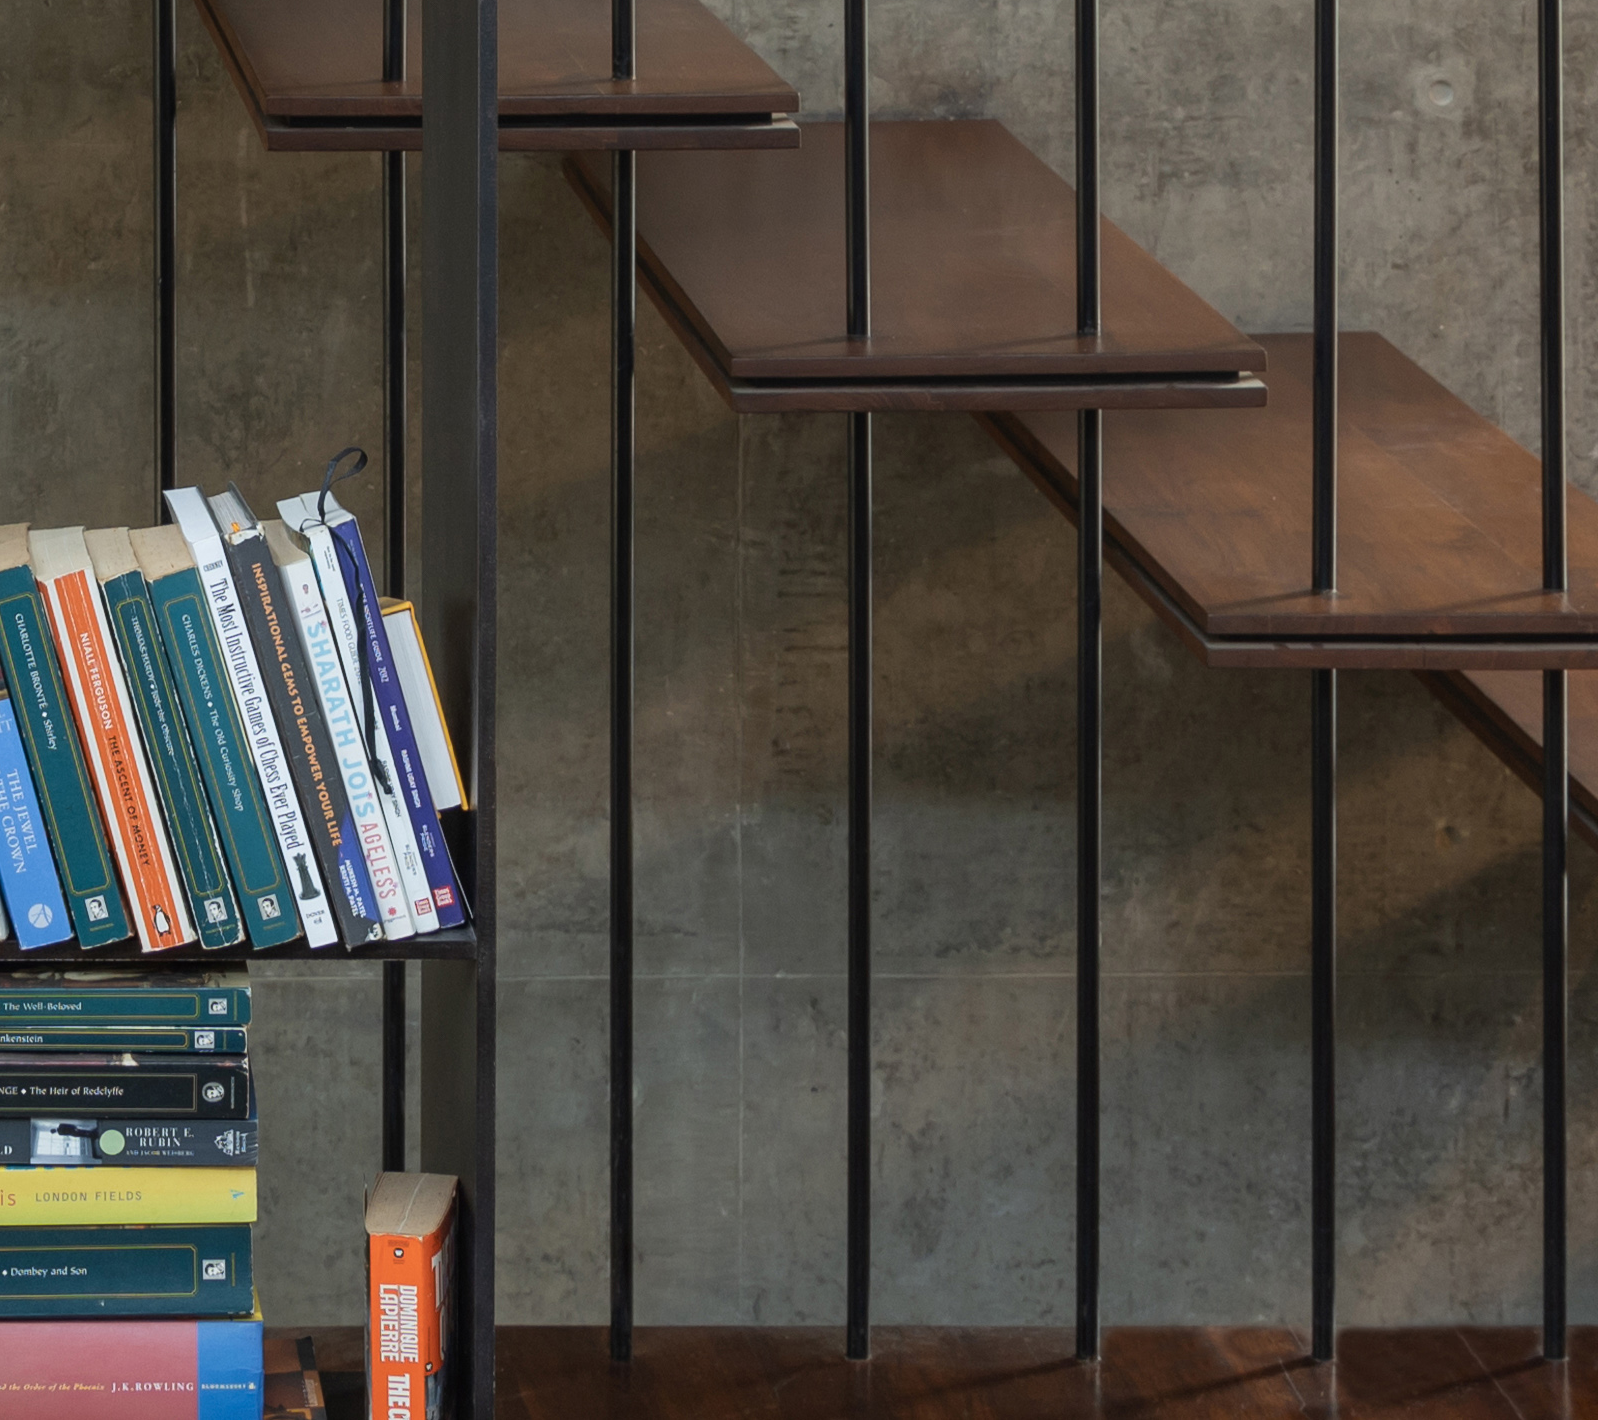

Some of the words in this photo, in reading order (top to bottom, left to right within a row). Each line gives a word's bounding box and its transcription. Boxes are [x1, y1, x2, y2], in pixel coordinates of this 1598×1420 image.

[80, 632, 95, 666] NIALL
[90, 665, 113, 730] FERGUSON
[306, 620, 356, 748] SHARATH
[342, 760, 376, 819] JOIS
[7, 769, 24, 802] THE
[14, 805, 38, 854] JEWEL
[35, 1192, 87, 1203] LONDON
[96, 1191, 142, 1201] FIELDS
[380, 1283, 398, 1362] LAPIERRE
[401, 1285, 418, 1363] DOMINIQUE
[111, 1382, 194, 1393] J.K.ROWLING
